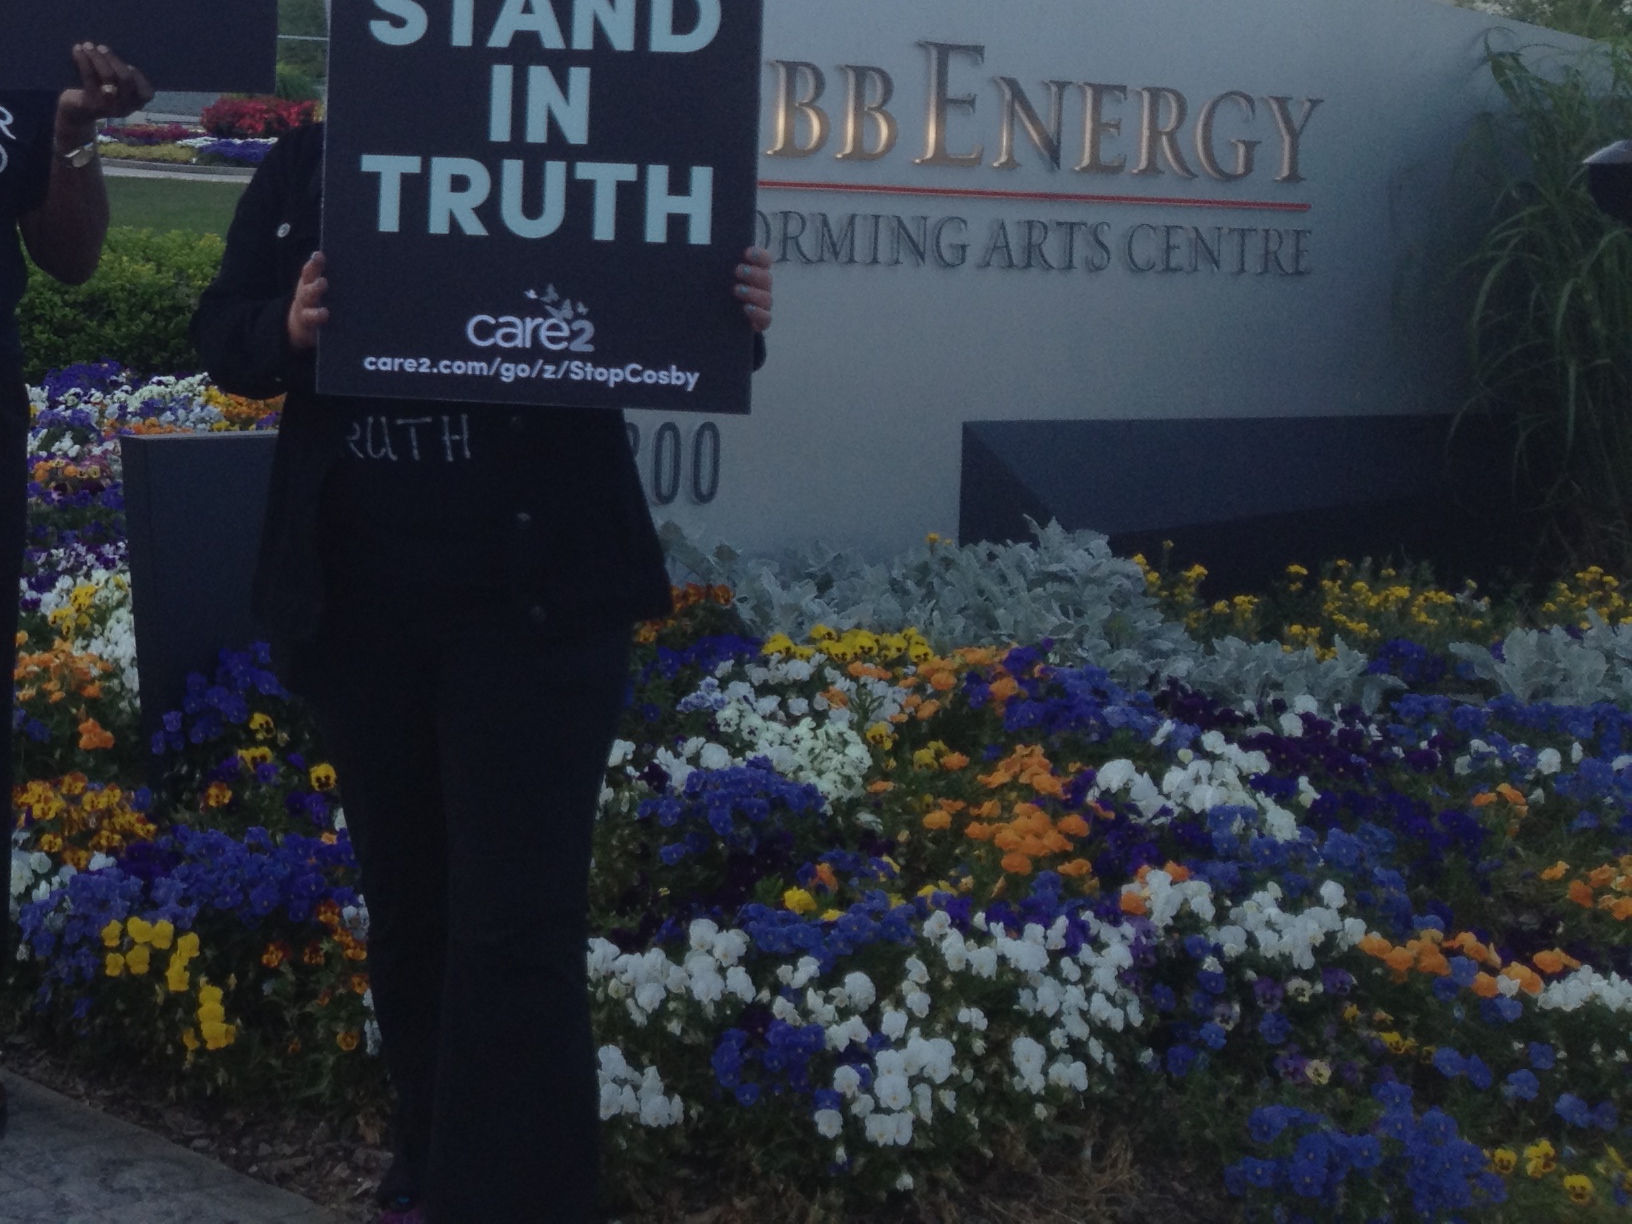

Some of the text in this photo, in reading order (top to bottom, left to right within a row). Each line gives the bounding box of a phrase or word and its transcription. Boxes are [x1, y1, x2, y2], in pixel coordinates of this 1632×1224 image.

[488, 64, 591, 145] IN
[766, 58, 898, 162] BB
[360, 153, 714, 245] TRUTH
[755, 210, 1313, 277] RMING ARTS CENTRE
[467, 310, 595, 353] care2
[363, 353, 700, 392] care2.com/go/z/StopCosby
